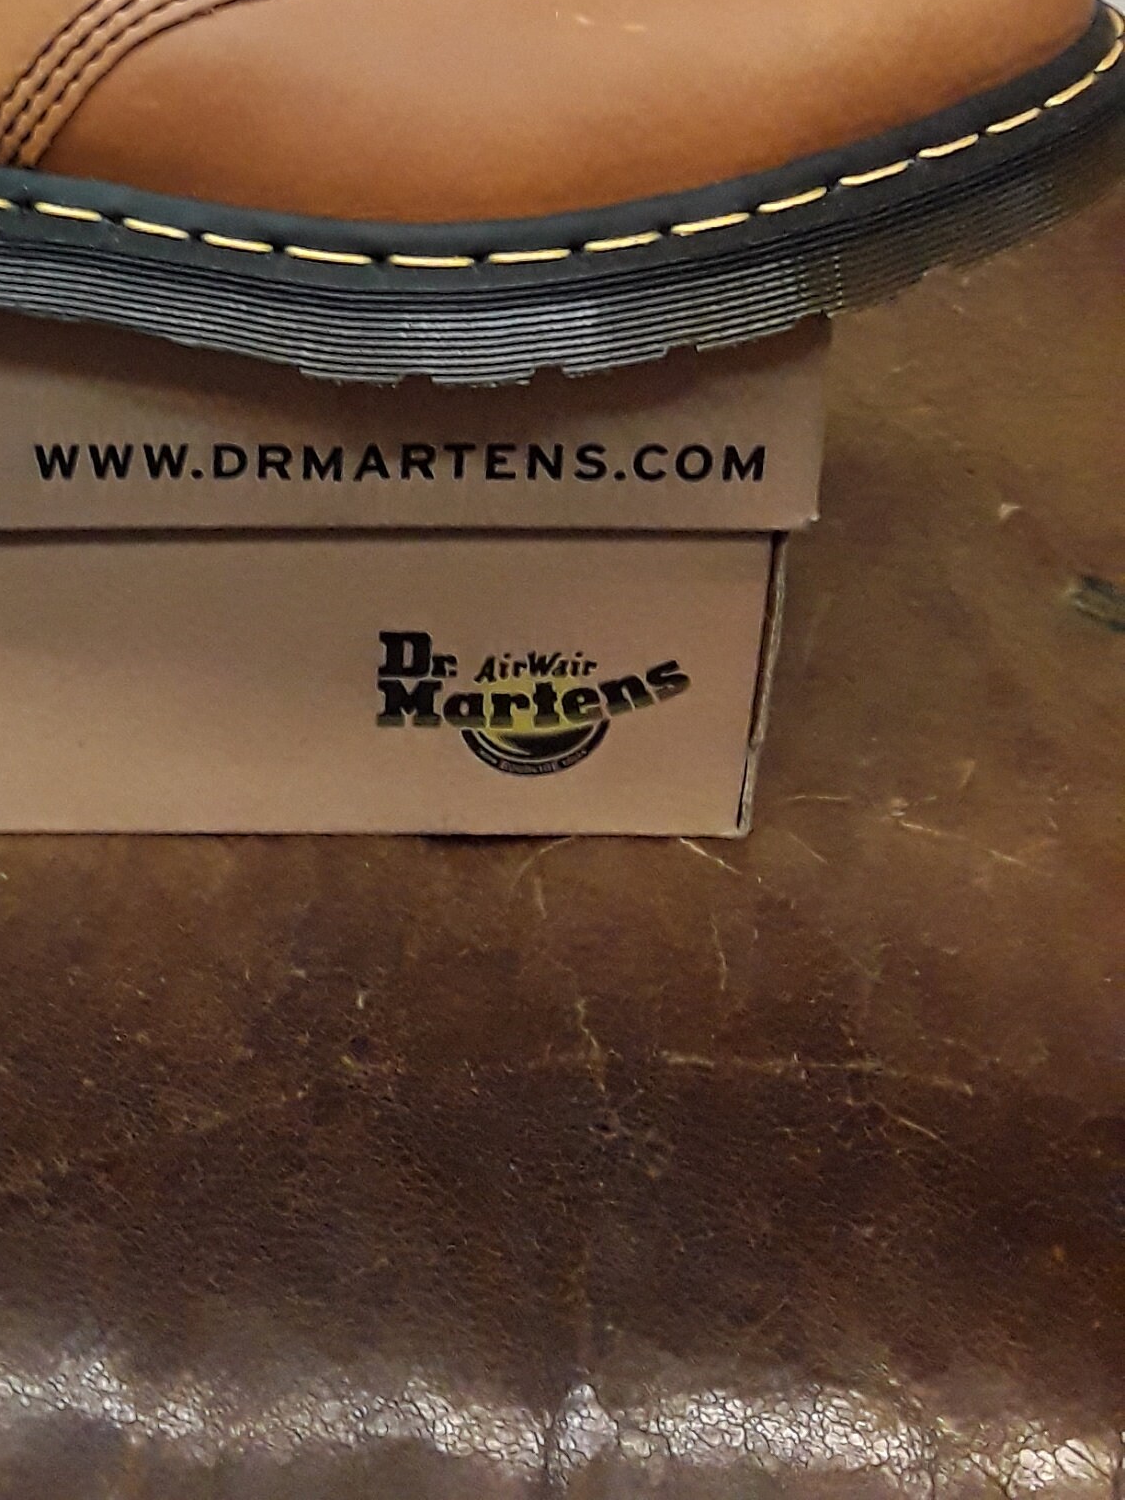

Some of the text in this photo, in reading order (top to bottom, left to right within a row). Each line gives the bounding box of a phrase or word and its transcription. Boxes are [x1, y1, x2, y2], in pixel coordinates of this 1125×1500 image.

[34, 442, 767, 484] WWW.DRMARTENS.COM
[378, 631, 598, 683] Dr. AirWair
[376, 659, 691, 729] Martens
